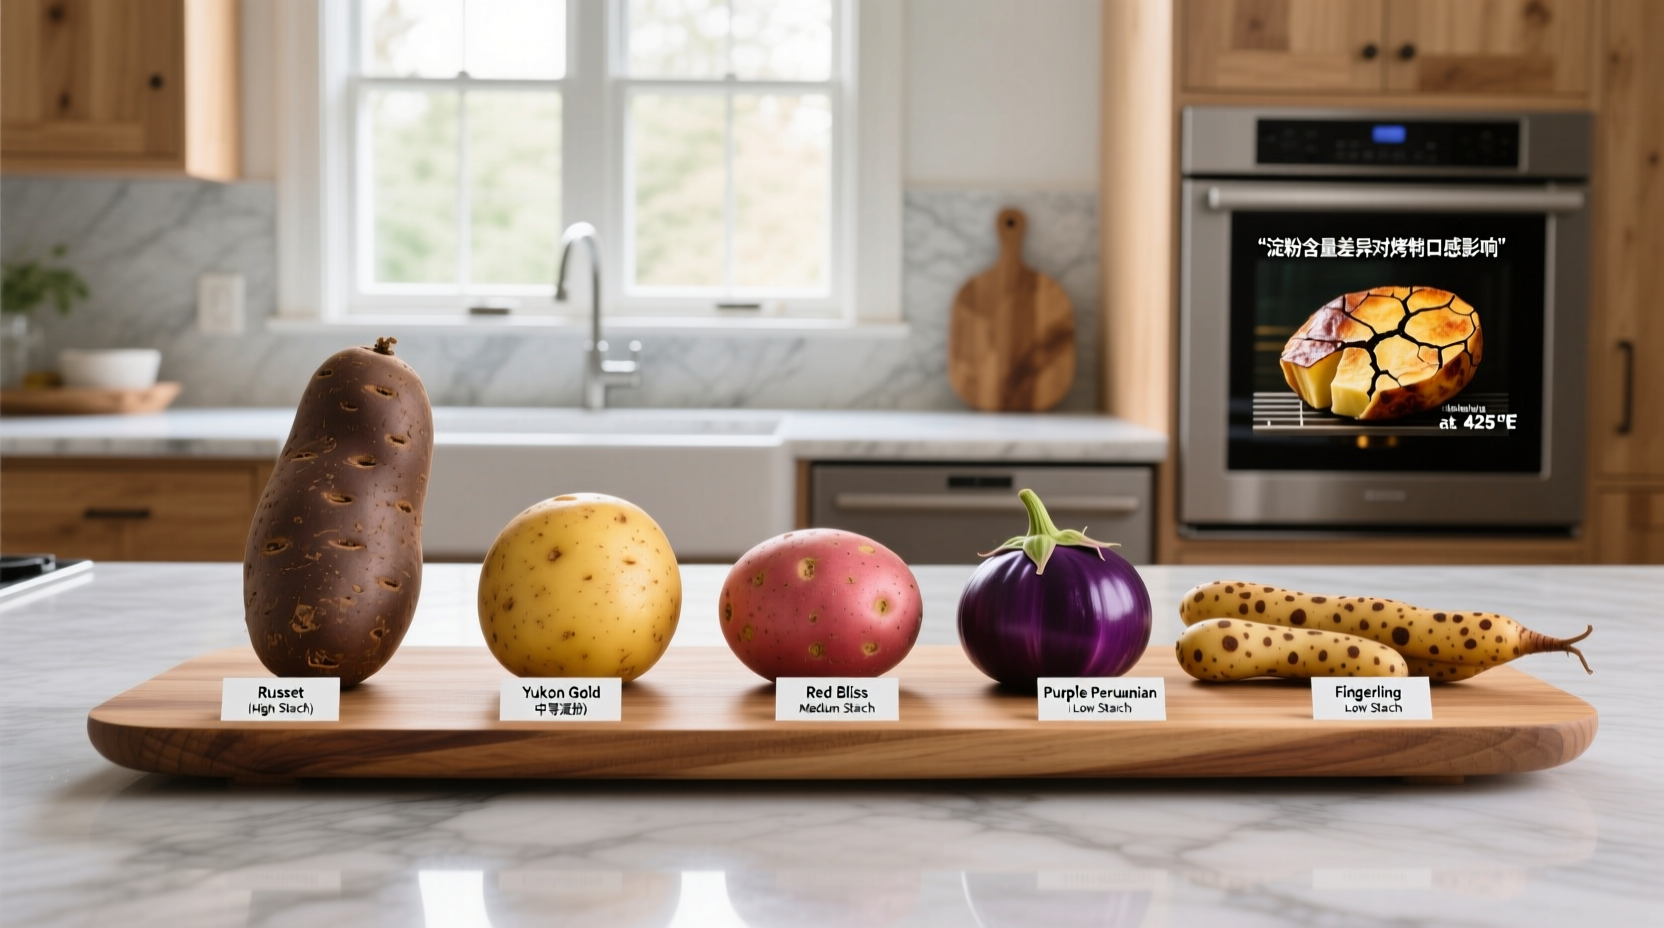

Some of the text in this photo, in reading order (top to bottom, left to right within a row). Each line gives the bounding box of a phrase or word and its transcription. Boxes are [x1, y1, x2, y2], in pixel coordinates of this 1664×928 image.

[258, 685, 304, 699] Russet
[521, 685, 601, 699] Yukon Gold
[806, 686, 869, 699] Red Bliss
[1043, 684, 1088, 703] Purple
[1335, 685, 1402, 703] Fingerling
[1345, 704, 1368, 713] Low
